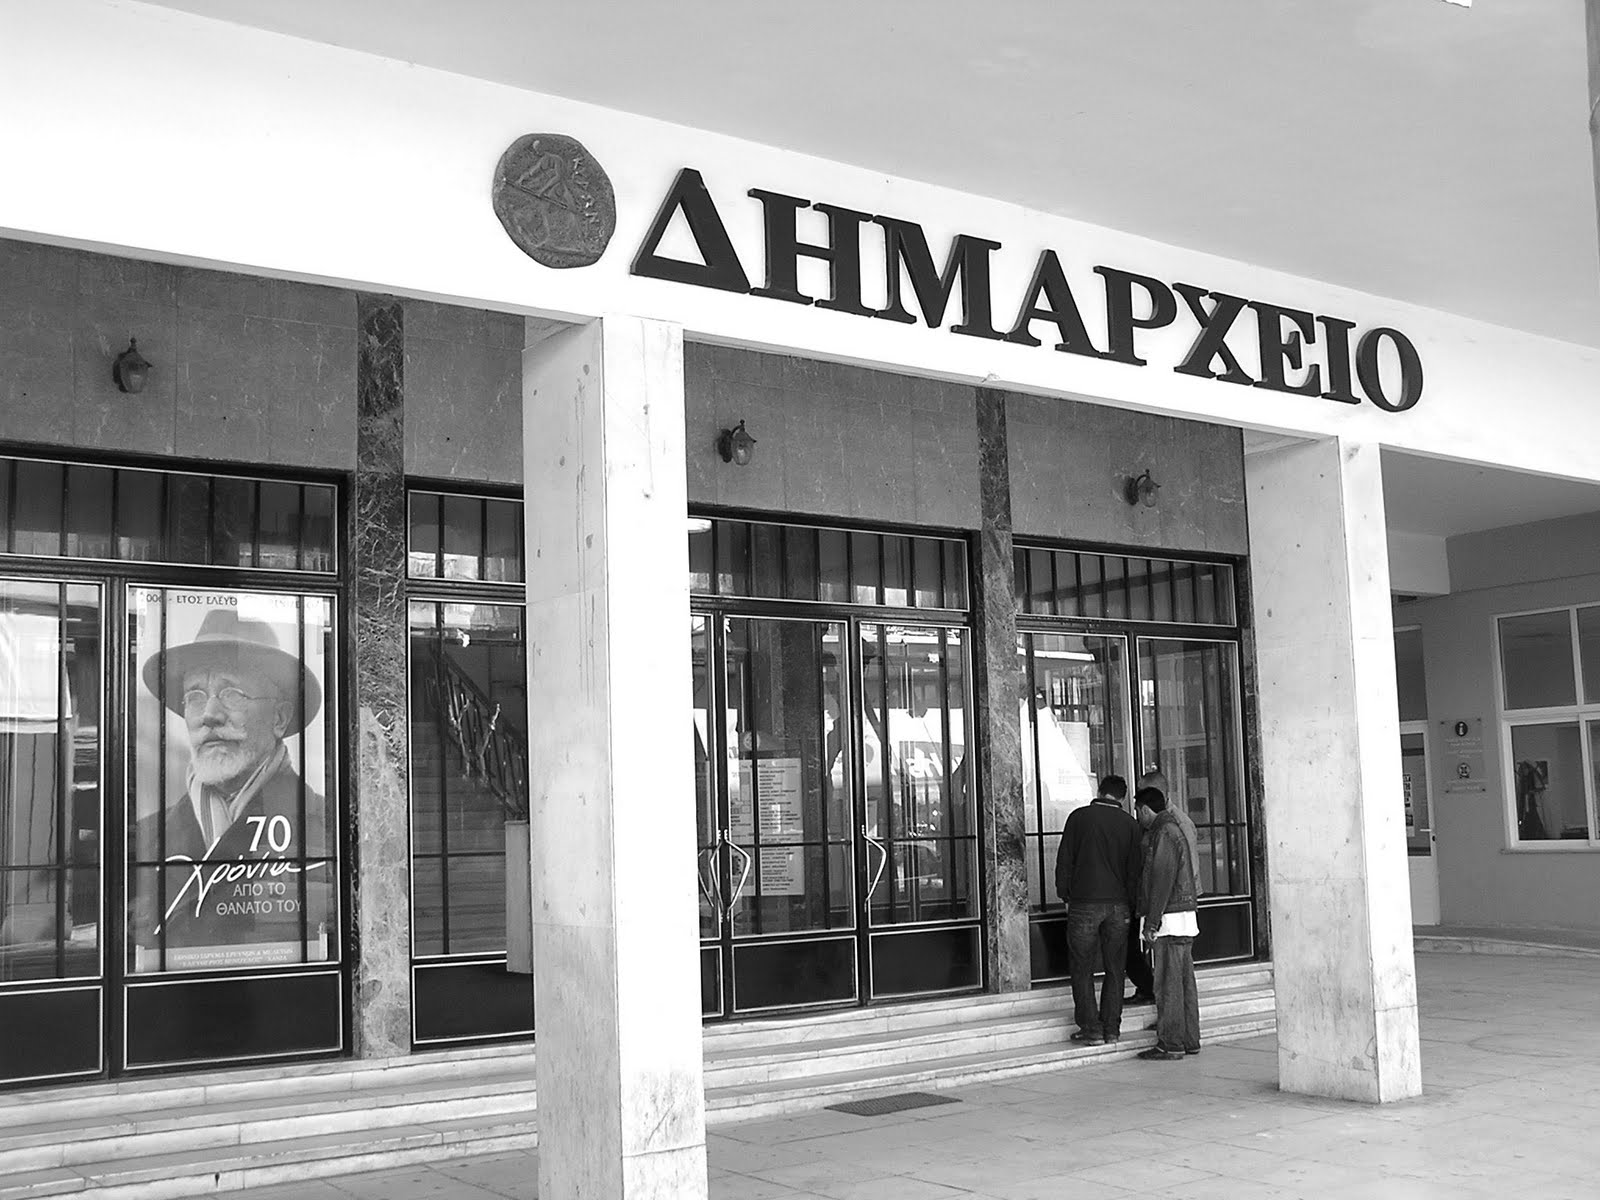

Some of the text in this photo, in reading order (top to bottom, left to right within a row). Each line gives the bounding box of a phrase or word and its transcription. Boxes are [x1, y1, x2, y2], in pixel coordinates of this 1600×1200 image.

[629, 167, 1424, 412] ΔΗΜΑΡΧΕΙΟ
[176, 595, 202, 605] ΕΤΟΣ
[206, 596, 238, 606] ΕΛΕΥΘ
[246, 815, 291, 852] 70
[233, 882, 286, 897] ΑΠΟ ΤΟ
[216, 899, 302, 916] ΘΑΝΑΤΟ ΤΟΥ
